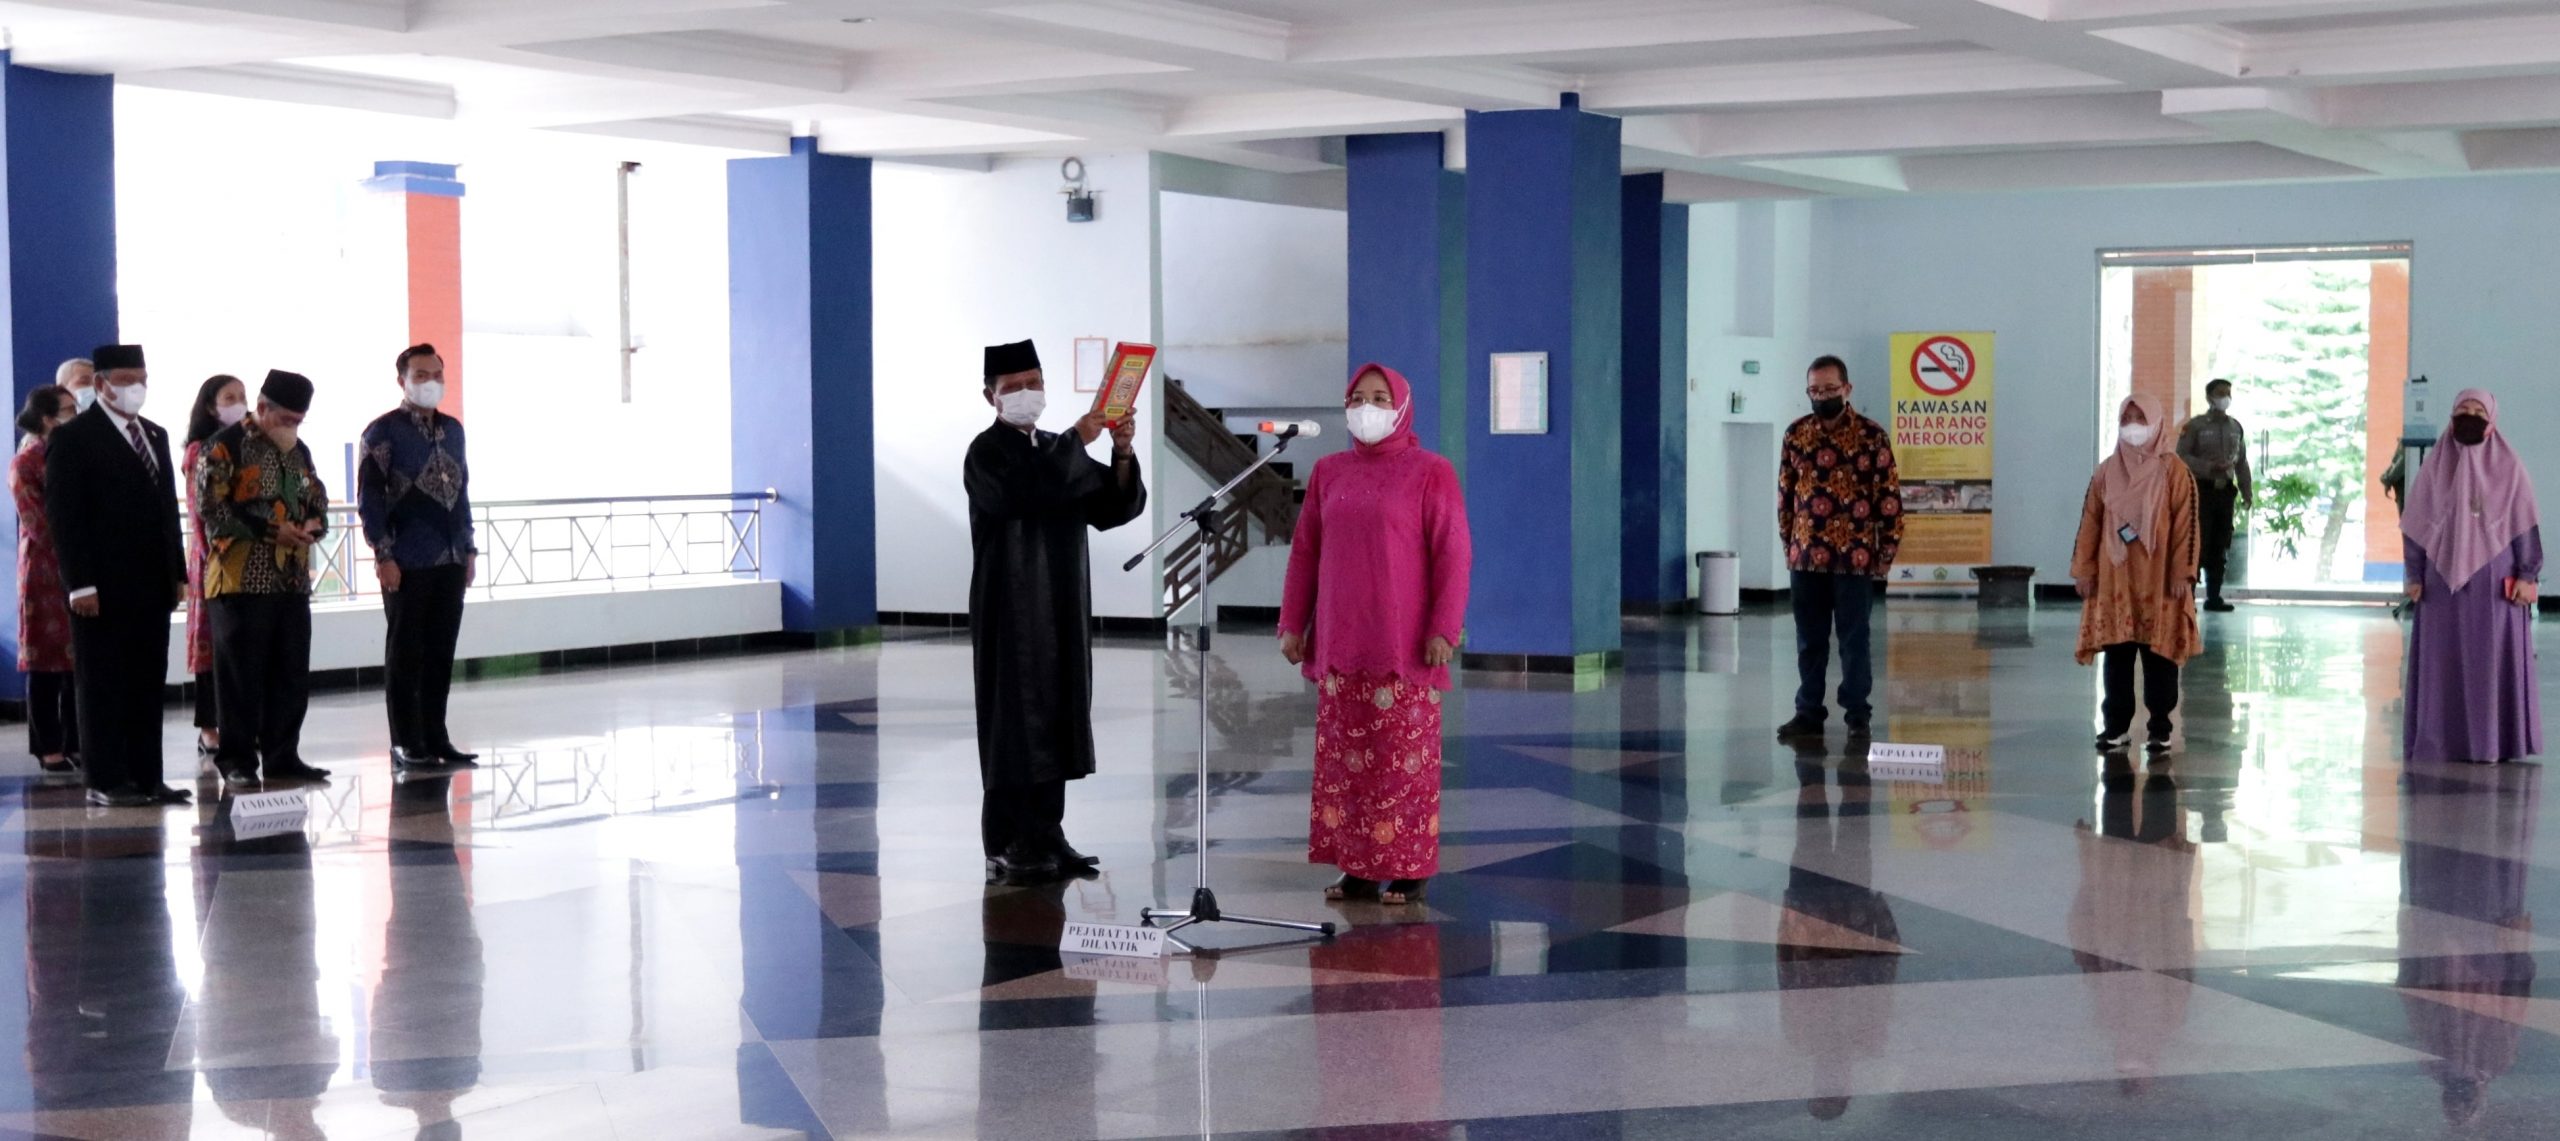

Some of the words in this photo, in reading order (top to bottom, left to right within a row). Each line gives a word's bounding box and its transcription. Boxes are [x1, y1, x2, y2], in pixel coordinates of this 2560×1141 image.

[1897, 400, 1987, 414] KAWASAN
[1896, 415, 1987, 430] DILARANG
[1897, 431, 1985, 446] MEROKOK
[241, 794, 304, 811] UNDANGAN
[1068, 925, 1122, 939] PEJABAT
[1124, 929, 1157, 942] YANG
[1080, 938, 1139, 953] DILANTIK
